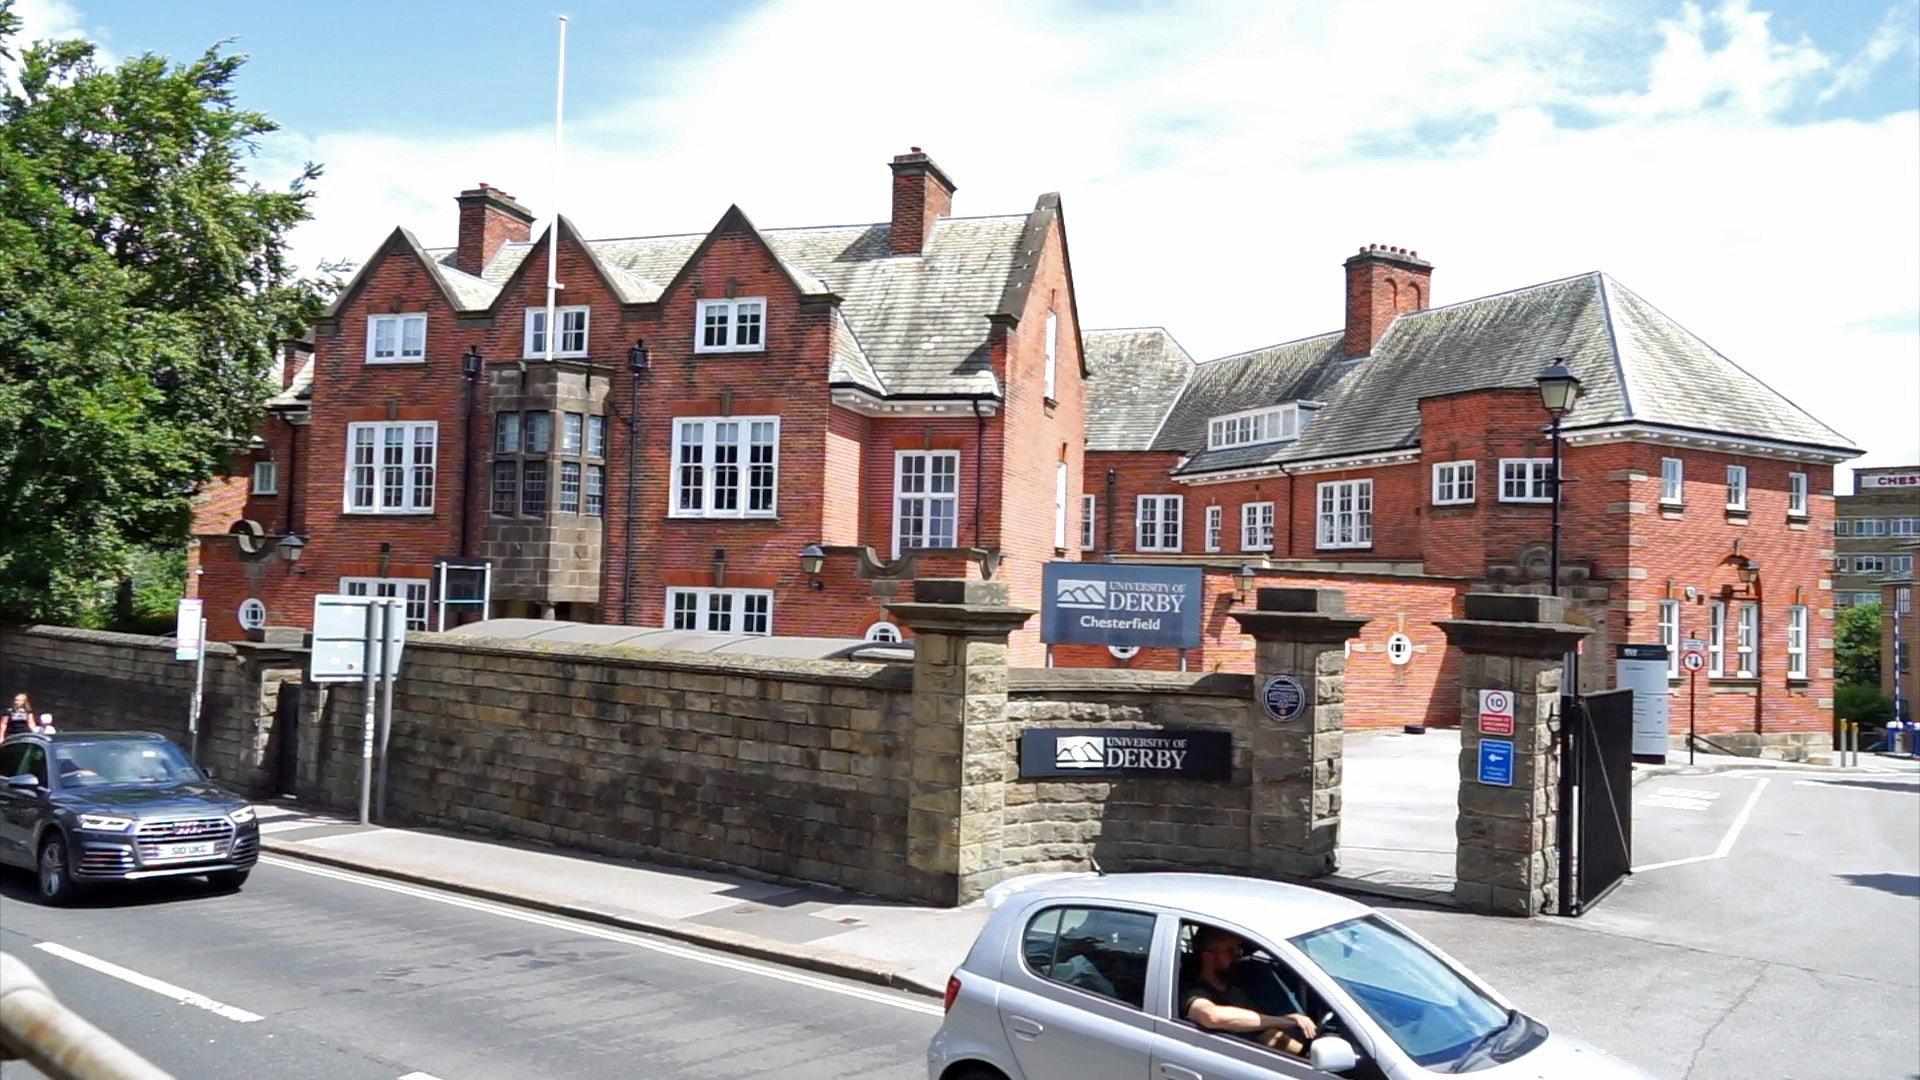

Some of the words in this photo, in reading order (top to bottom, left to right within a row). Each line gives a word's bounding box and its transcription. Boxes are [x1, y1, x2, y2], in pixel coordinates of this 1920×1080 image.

[1878, 476, 1920, 485] CHES
[1109, 581, 1169, 593] UNIVERSITY
[1172, 584, 1187, 593] OF
[1109, 592, 1186, 613] DERBY
[1080, 615, 1160, 630] Chesterfield
[1490, 698, 1503, 707] 10
[1106, 736, 1171, 748] UNIVERSITY
[1173, 739, 1187, 748] OF
[1106, 747, 1187, 769] DERBY
